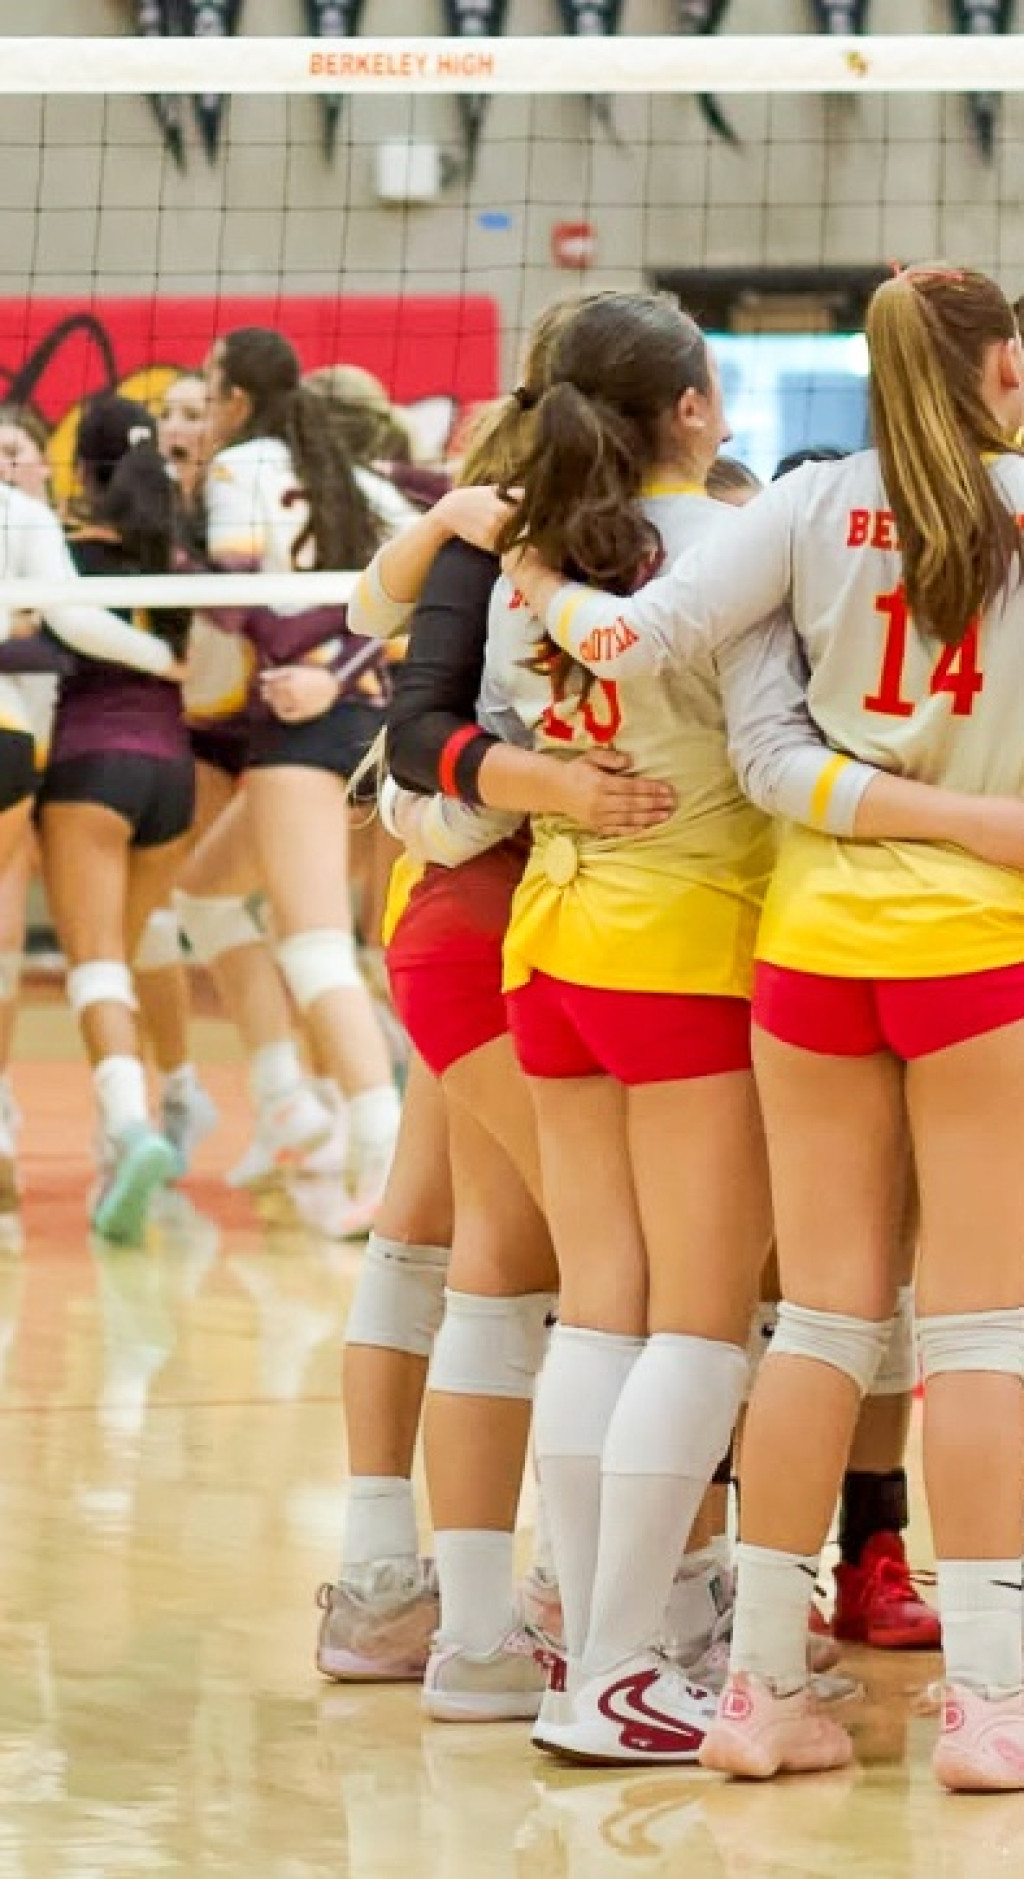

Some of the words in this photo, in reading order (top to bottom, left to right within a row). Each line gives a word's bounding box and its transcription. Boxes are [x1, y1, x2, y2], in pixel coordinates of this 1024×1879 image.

[309, 52, 427, 76] BERKELEY
[437, 52, 495, 76] HIGH
[864, 580, 983, 717] 14
